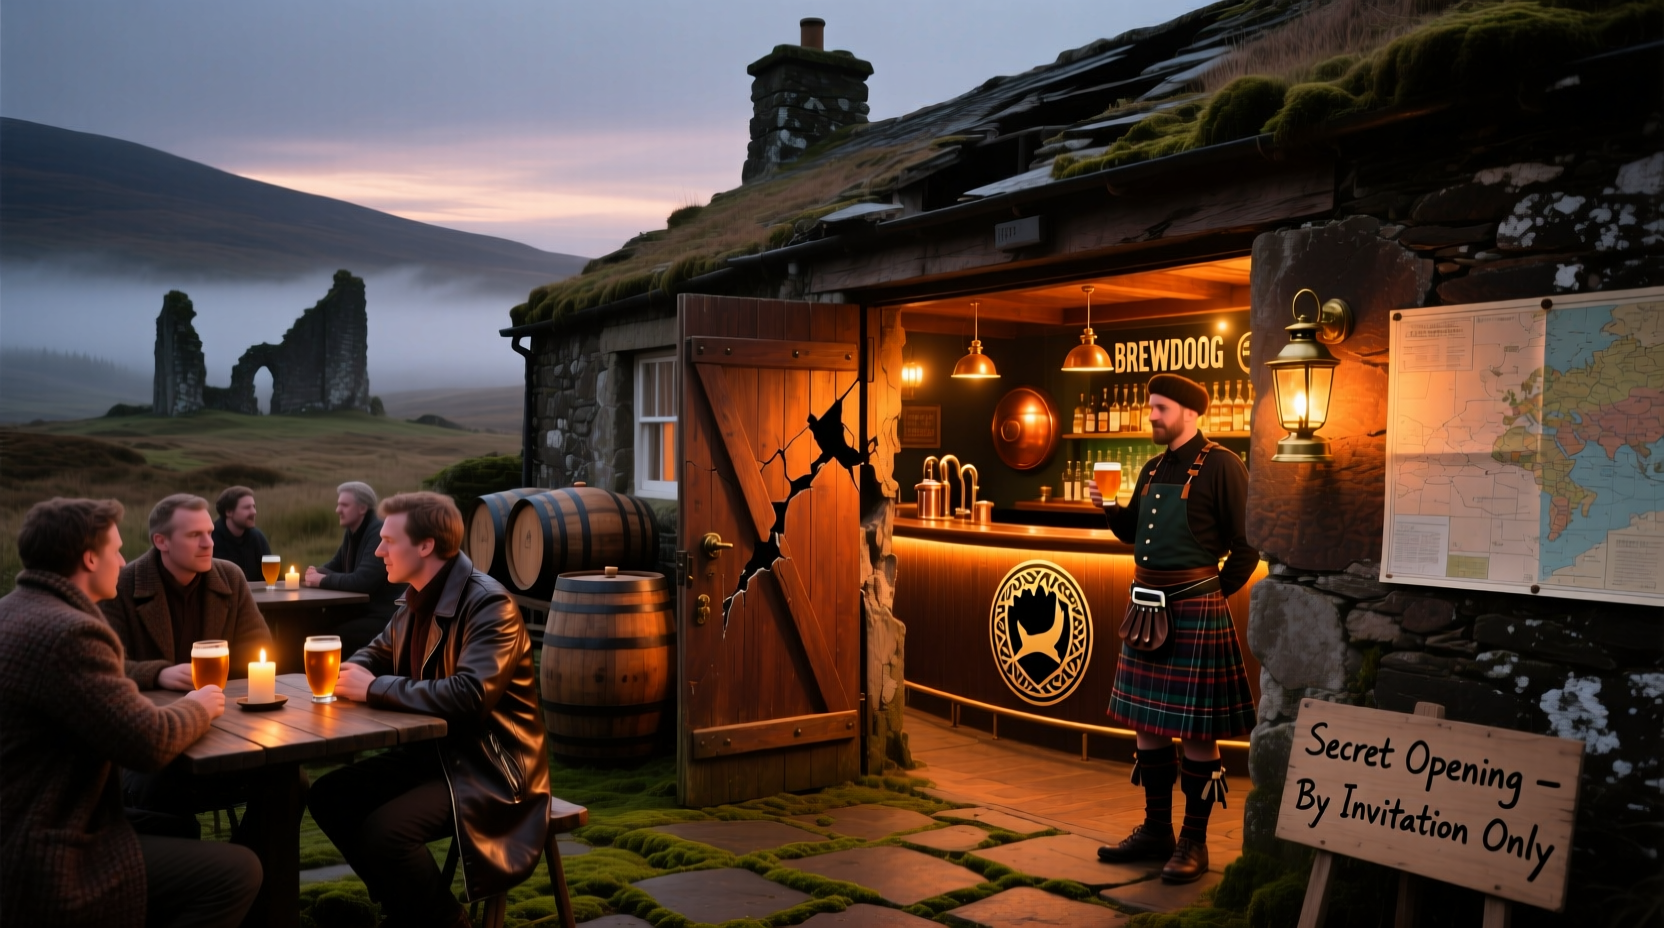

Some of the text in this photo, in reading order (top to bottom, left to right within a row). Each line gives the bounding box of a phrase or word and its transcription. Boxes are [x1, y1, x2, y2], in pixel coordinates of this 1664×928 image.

[1114, 335, 1224, 374] BREWDOOG
[1305, 722, 1395, 769] Secret
[1405, 740, 1523, 809] Opening
[1295, 778, 1555, 882] By Invitation Only
